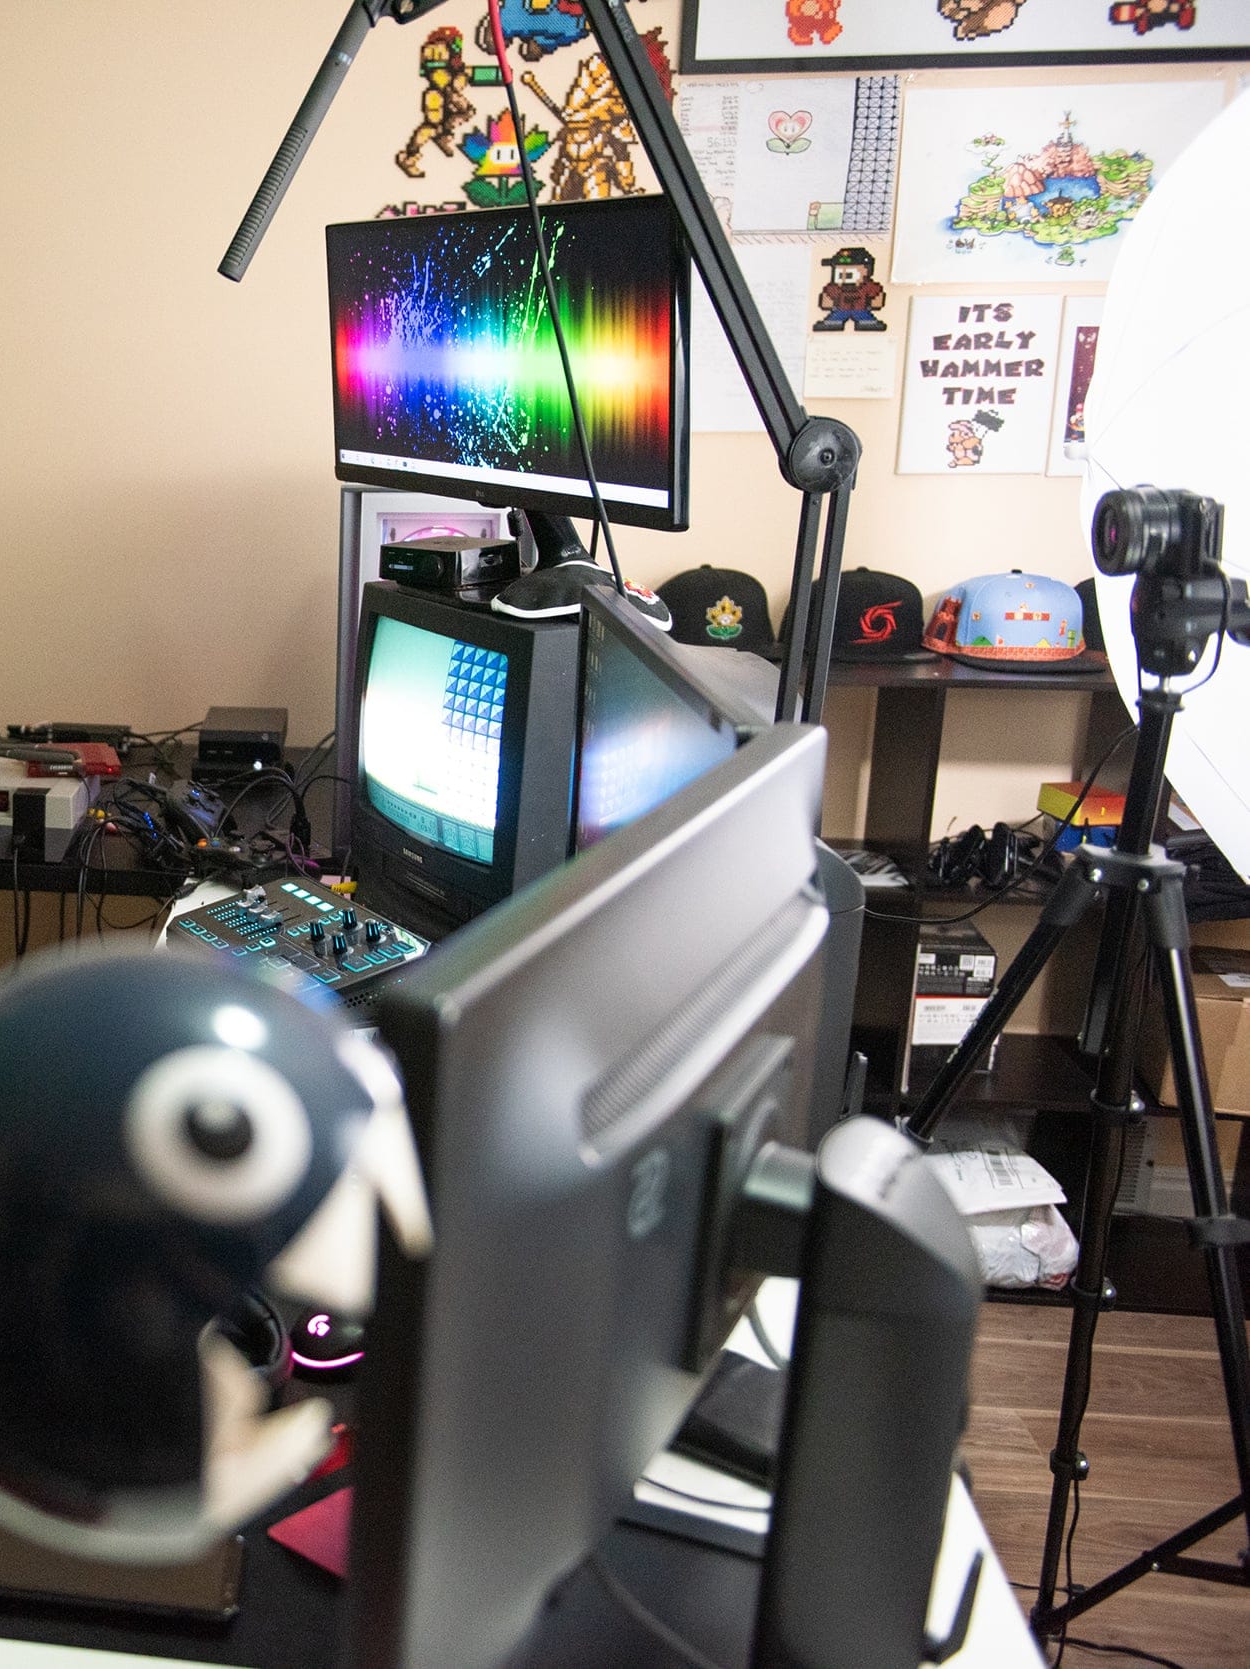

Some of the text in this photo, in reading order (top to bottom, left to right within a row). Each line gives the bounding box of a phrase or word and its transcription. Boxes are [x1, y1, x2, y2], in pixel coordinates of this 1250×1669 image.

[958, 303, 1014, 323] ITS
[933, 330, 1037, 351] EARLY
[920, 359, 1045, 378] HAMMER
[942, 386, 1017, 405] TIME
